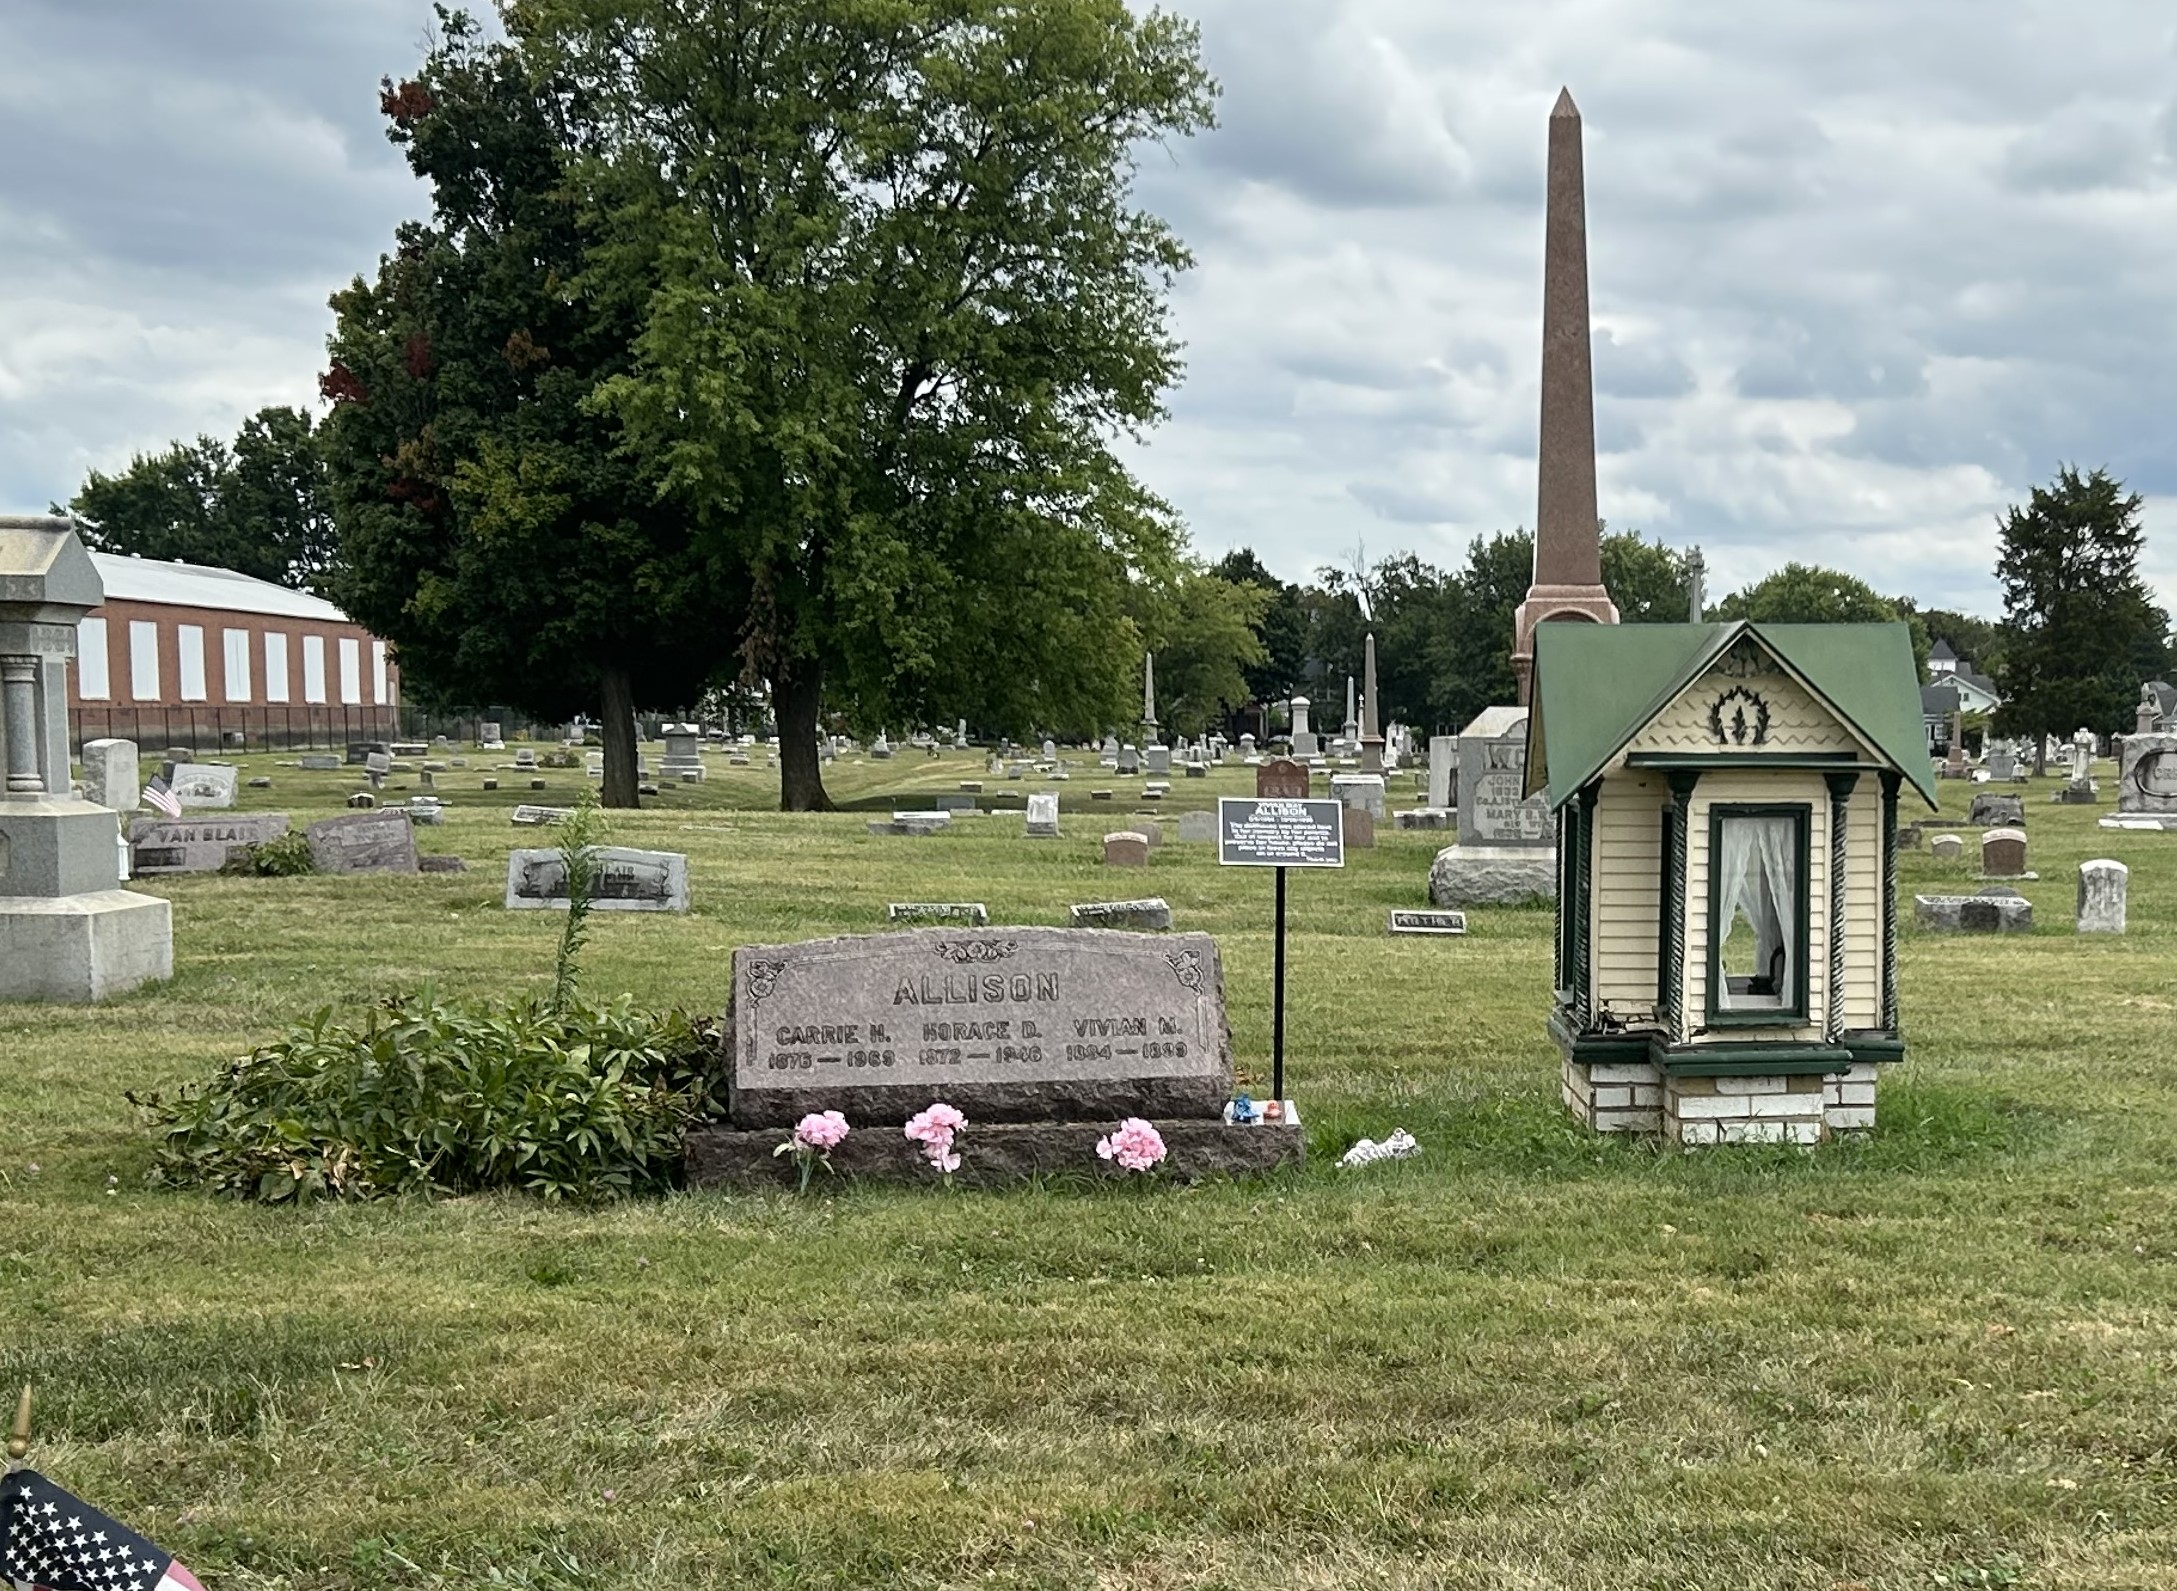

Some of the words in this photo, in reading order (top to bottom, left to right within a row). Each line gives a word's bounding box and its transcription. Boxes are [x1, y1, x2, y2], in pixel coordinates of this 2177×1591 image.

[1255, 806, 1307, 816] ALLISON
[157, 827, 196, 843] VAN
[893, 971, 1060, 1006] ALLISON
[775, 1024, 860, 1046] CARRIE
[922, 1020, 1011, 1042] HORACE
[1020, 1019, 1043, 1039] D.
[1072, 1016, 1147, 1038] VIVIAN
